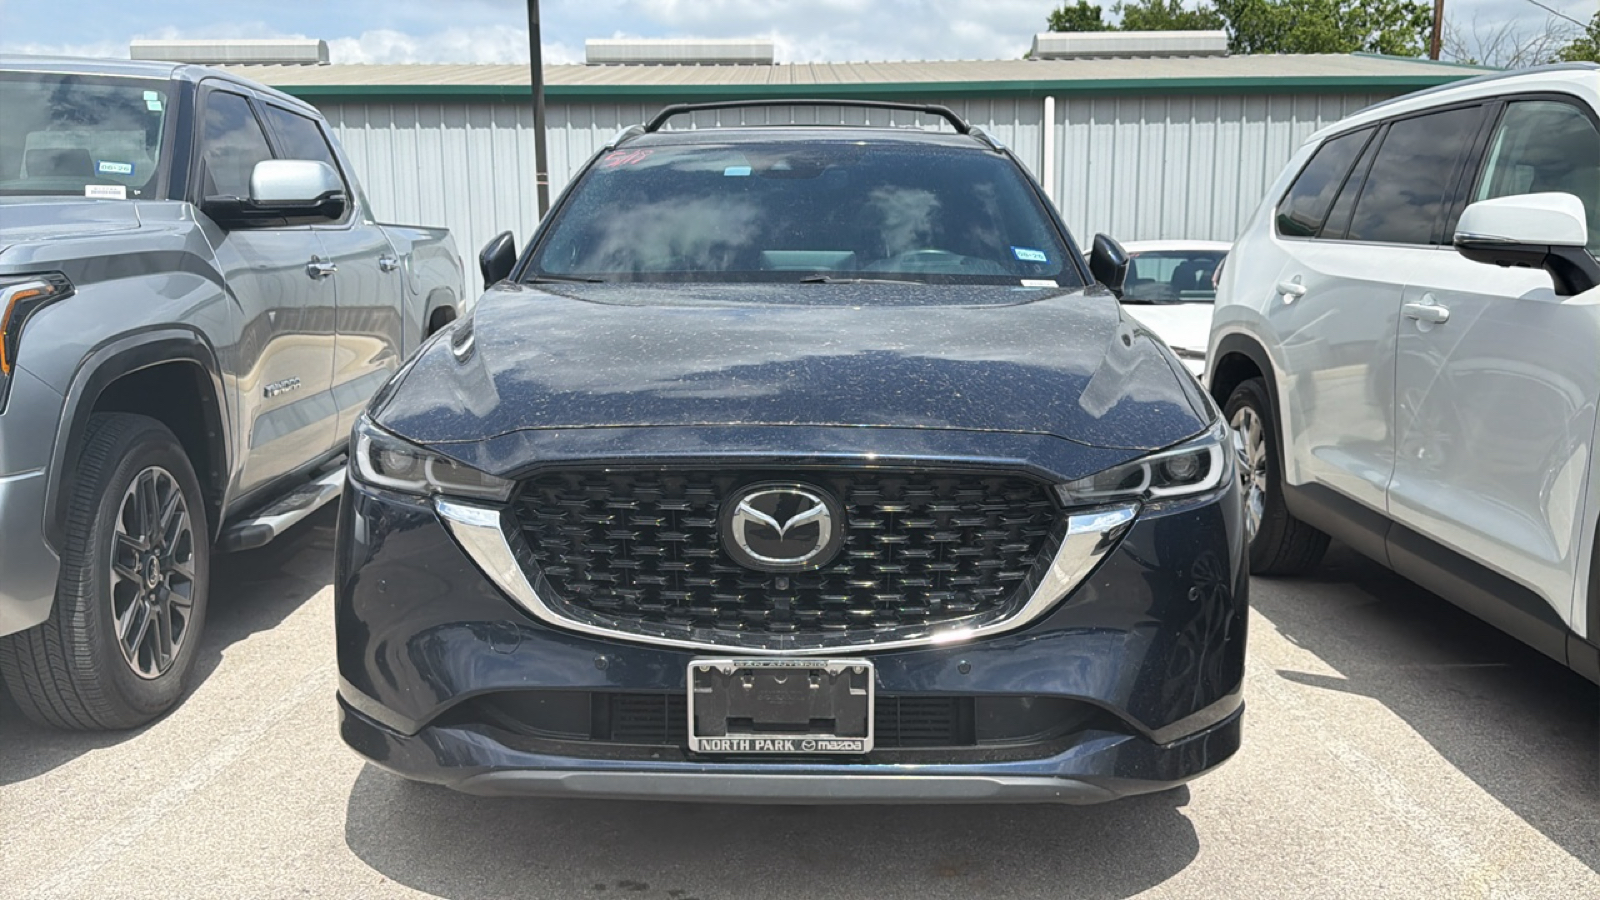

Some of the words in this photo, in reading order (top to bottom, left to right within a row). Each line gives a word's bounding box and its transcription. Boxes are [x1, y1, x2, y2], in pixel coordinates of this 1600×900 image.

[701, 739, 750, 751] NORTH
[755, 739, 795, 751] PARK
[818, 741, 862, 751] mazda
